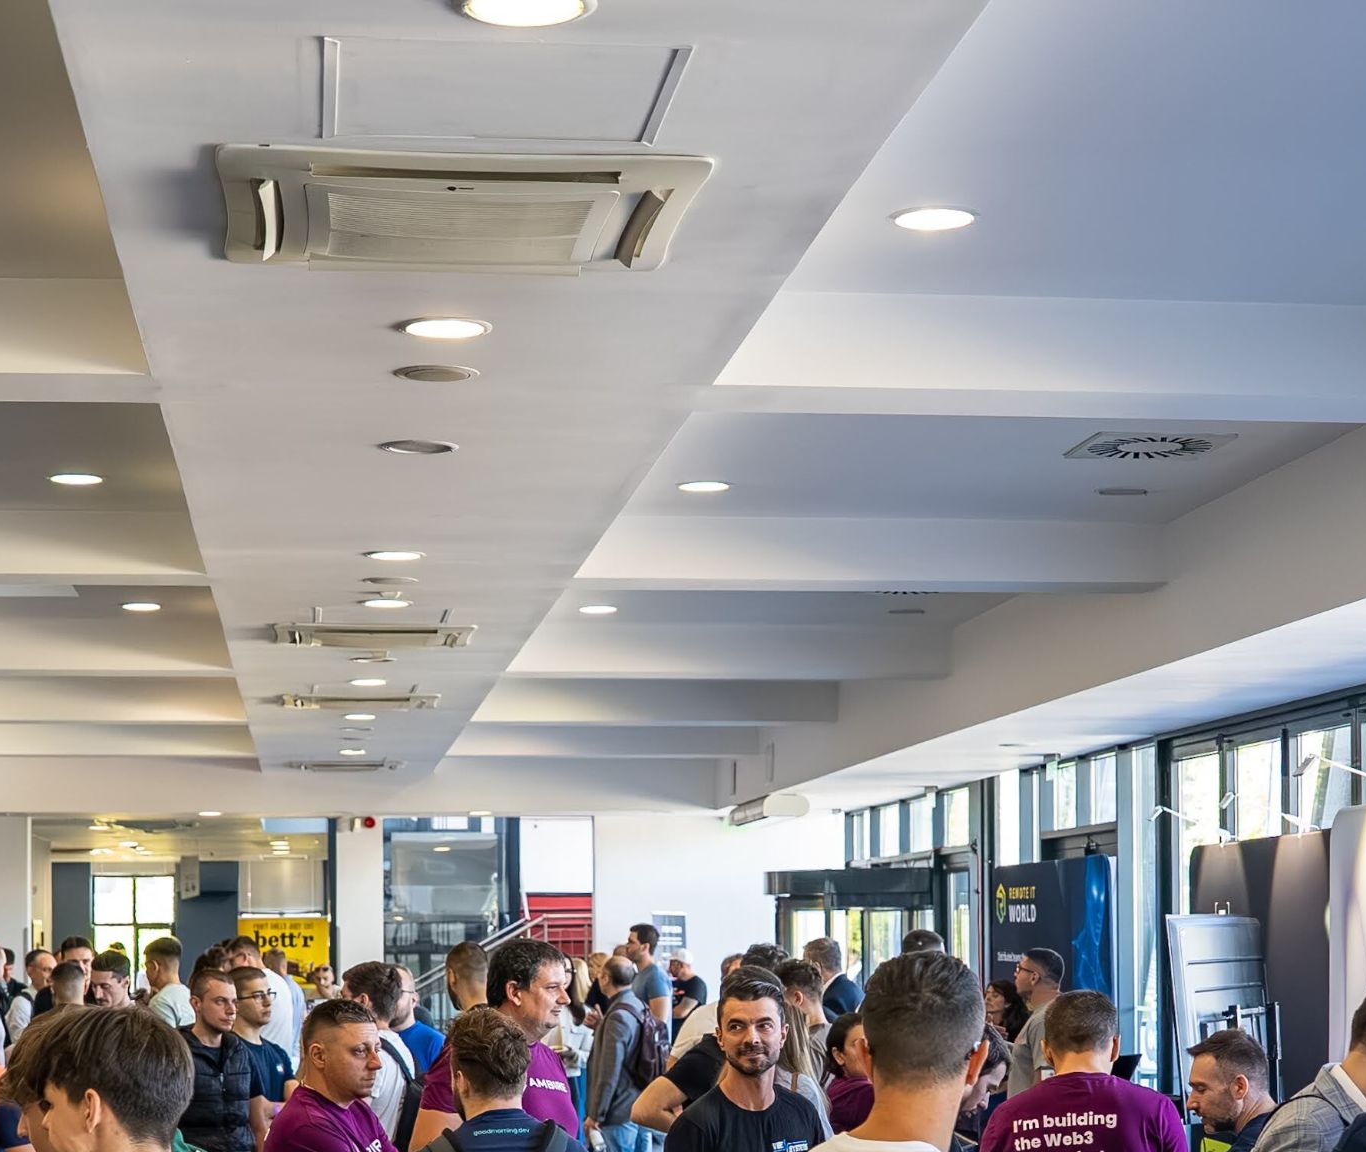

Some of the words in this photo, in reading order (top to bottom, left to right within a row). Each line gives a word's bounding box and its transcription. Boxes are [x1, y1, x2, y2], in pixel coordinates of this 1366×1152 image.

[1008, 904, 1037, 923] WORLD
[529, 1077, 568, 1093] AMBIRE
[1013, 1118, 1039, 1133] I'm
[1043, 1111, 1118, 1129] building
[1014, 1136, 1041, 1151] the
[1043, 1130, 1094, 1148] Web3
